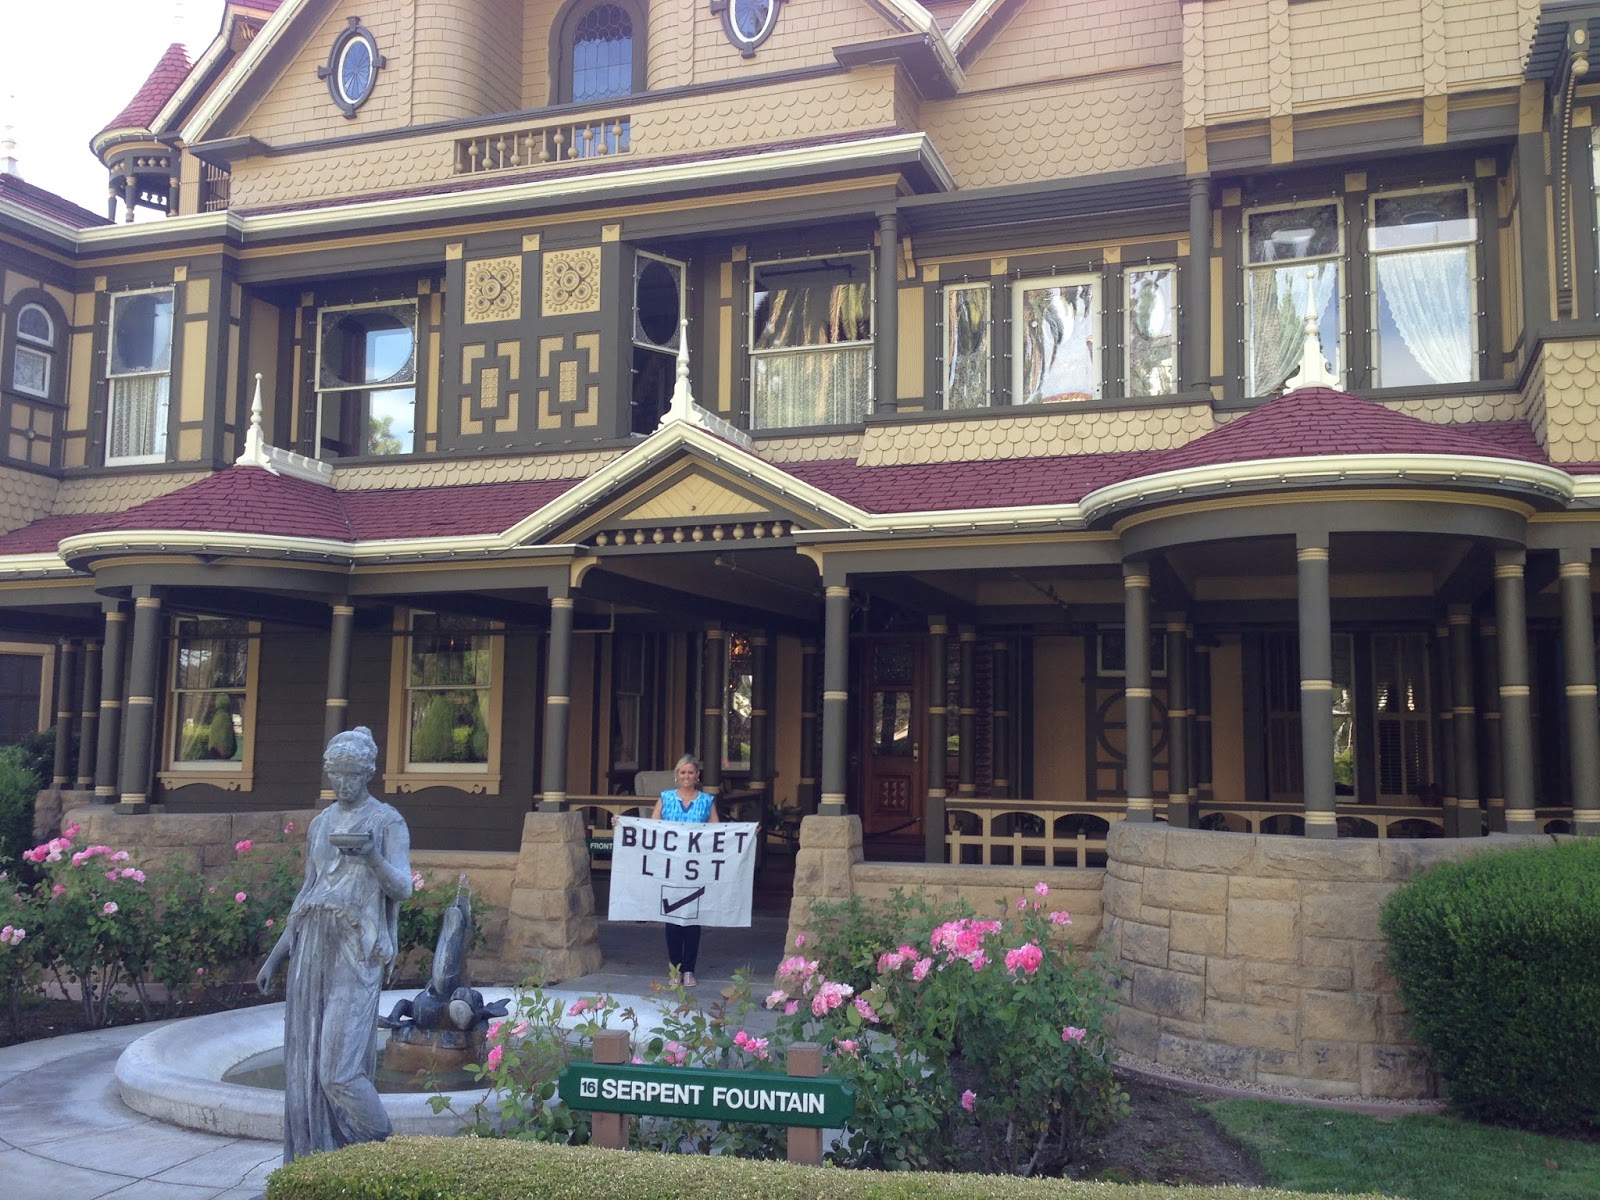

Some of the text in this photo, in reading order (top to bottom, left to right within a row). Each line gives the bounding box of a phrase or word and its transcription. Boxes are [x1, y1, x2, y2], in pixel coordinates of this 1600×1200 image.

[590, 842, 613, 850] FRONT
[622, 826, 748, 853] BUCKET
[642, 855, 725, 880] LIST
[581, 1078, 825, 1114] 16 SERPENT FOUNTAIN
